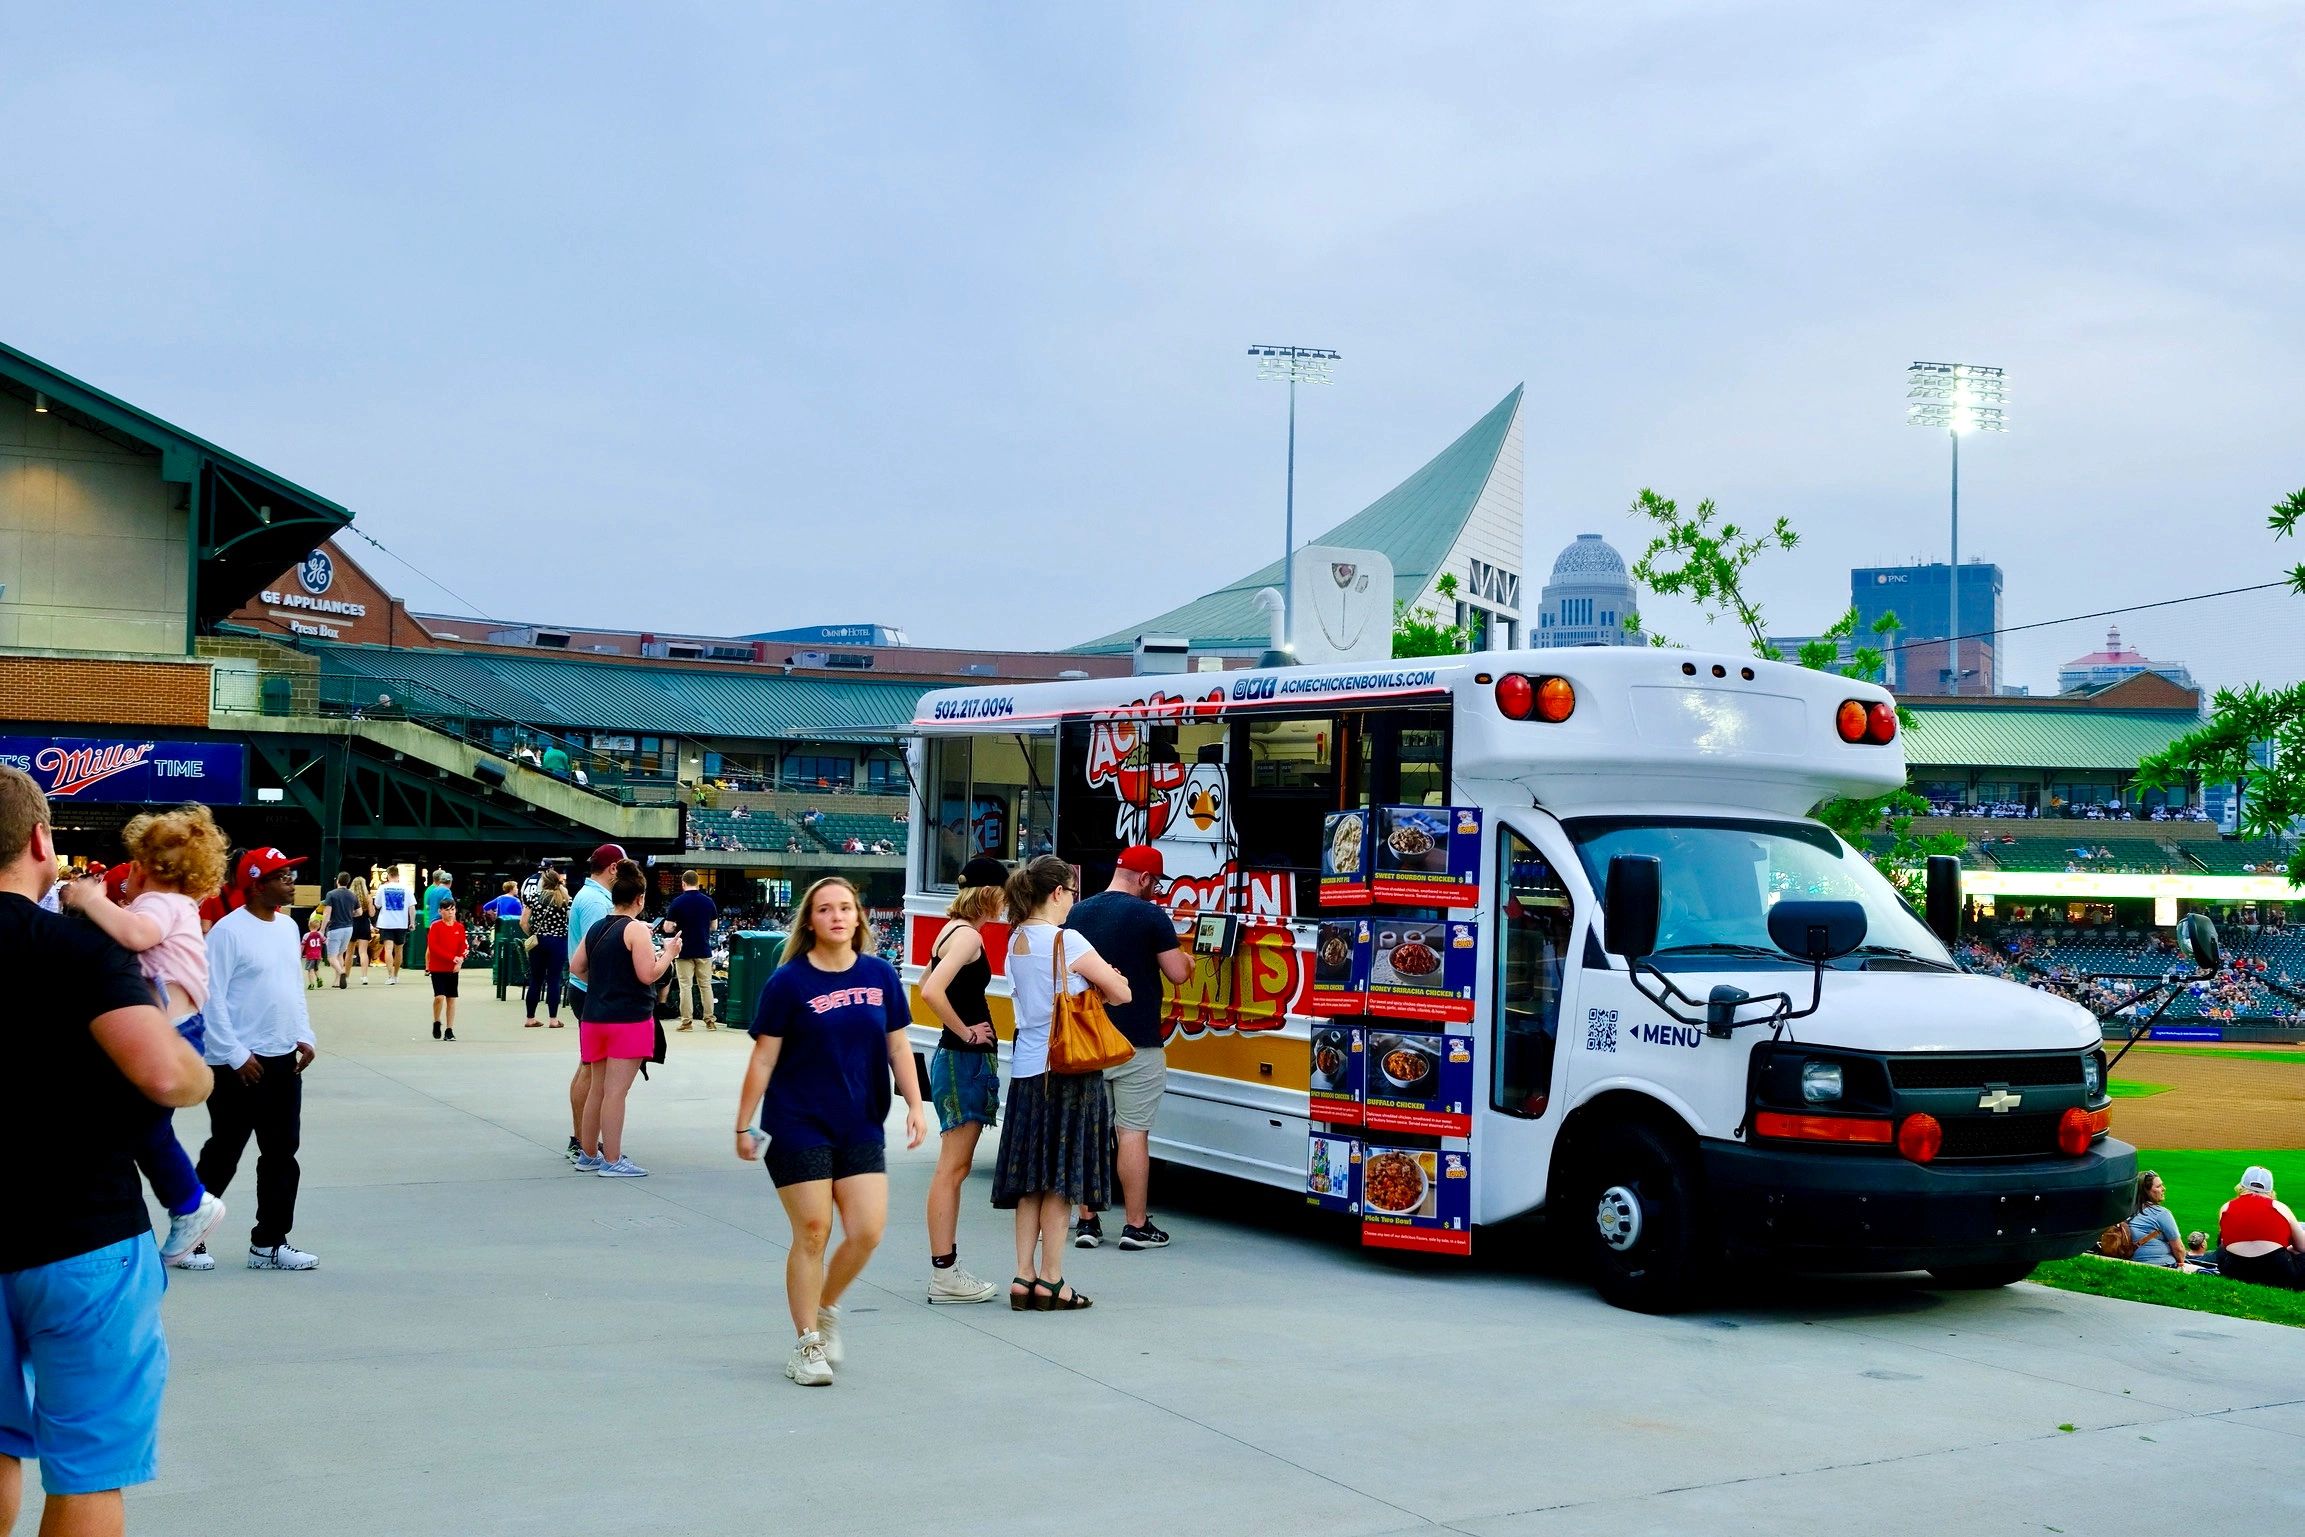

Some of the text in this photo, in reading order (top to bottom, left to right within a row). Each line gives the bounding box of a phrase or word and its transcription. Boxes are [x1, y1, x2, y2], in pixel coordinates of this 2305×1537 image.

[1887, 574, 1908, 582] PNC
[260, 590, 366, 617] GE APPLIANCES
[290, 620, 339, 639] Press Box
[821, 628, 870, 638] OMNI HOTEL
[1280, 671, 1435, 694] ACMECHICKENBOWLS.COM
[935, 697, 1014, 719] 502.217.0094
[0, 744, 205, 788] T'S Miller TIME
[310, 938, 321, 947] 01
[806, 987, 884, 1014] BATS
[1392, 987, 1424, 995] SRIRACHA
[1643, 1024, 1700, 1048] MENU
